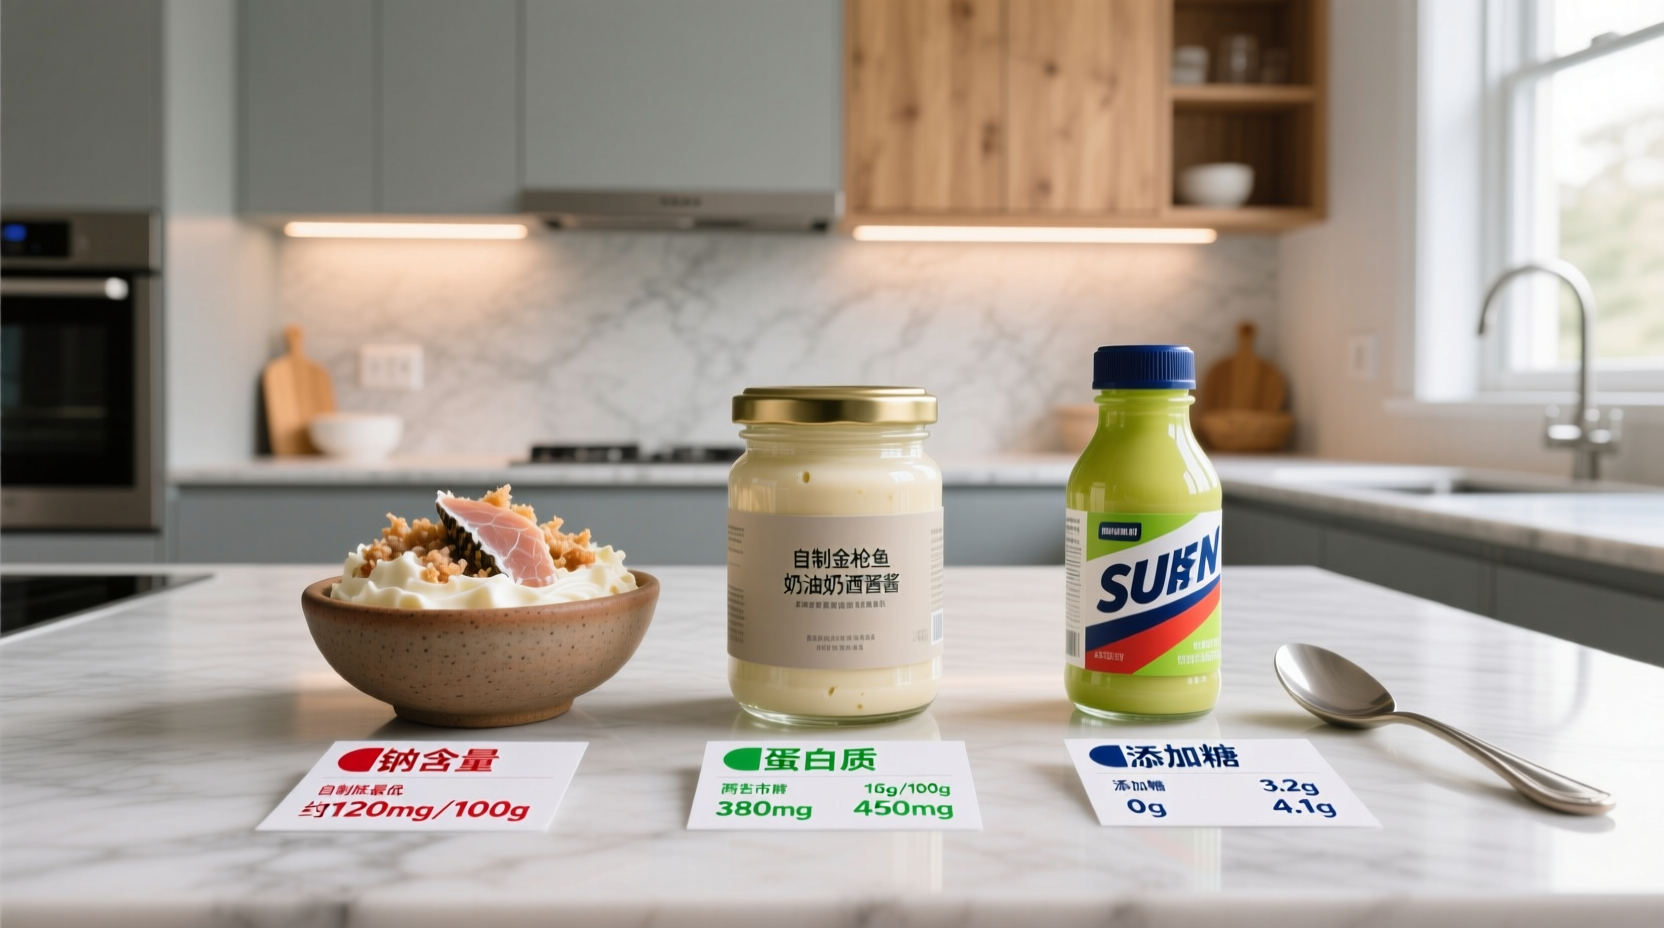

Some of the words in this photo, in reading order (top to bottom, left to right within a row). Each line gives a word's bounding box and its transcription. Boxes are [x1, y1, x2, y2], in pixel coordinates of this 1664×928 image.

[794, 548, 891, 570] 自制金枪鱼
[378, 747, 499, 773] 钠含量
[765, 747, 877, 772] 蛋白质
[1126, 743, 1240, 769] 添加糖
[1259, 778, 1319, 796] 3.2g
[298, 799, 530, 822] 约120mg/100g
[716, 800, 813, 820] 380mg
[853, 799, 954, 820] 450mg
[1126, 798, 1167, 818] 0g
[1273, 798, 1337, 818] 4.1g
